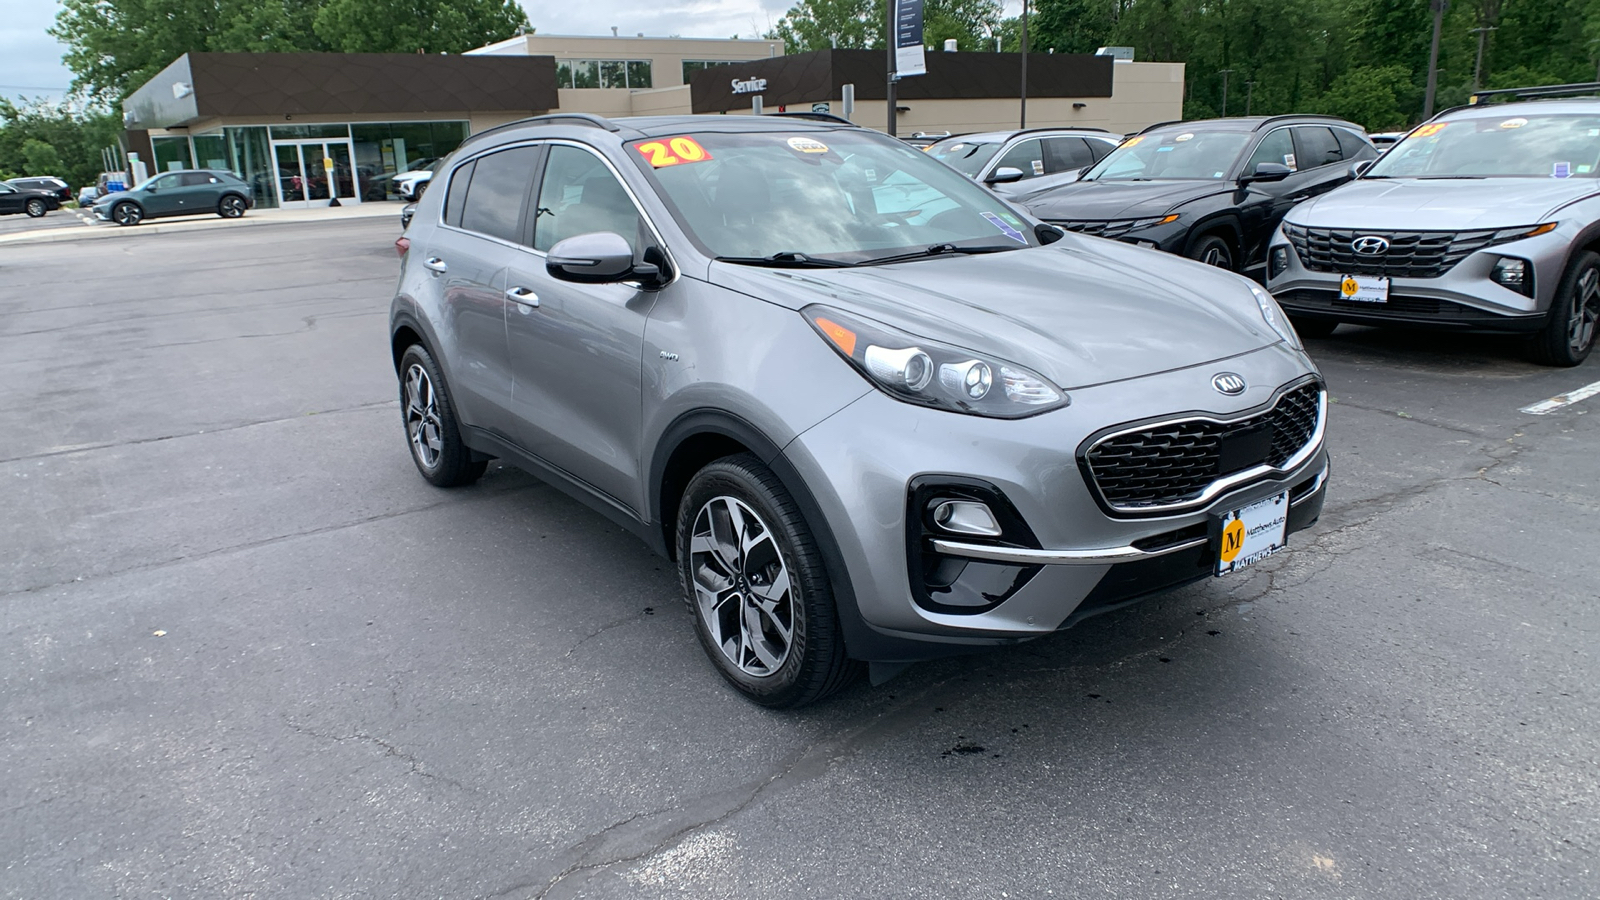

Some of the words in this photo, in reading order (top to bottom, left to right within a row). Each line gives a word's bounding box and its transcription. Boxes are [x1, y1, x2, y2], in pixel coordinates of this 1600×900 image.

[731, 76, 767, 94] Service
[639, 137, 703, 167] 20
[1345, 283, 1356, 292] M
[1215, 375, 1245, 391] KIA
[1246, 523, 1272, 537] Matthews
[1272, 516, 1286, 526] Auto
[1224, 528, 1242, 554] M
[1233, 546, 1272, 571] MATTHEWS
